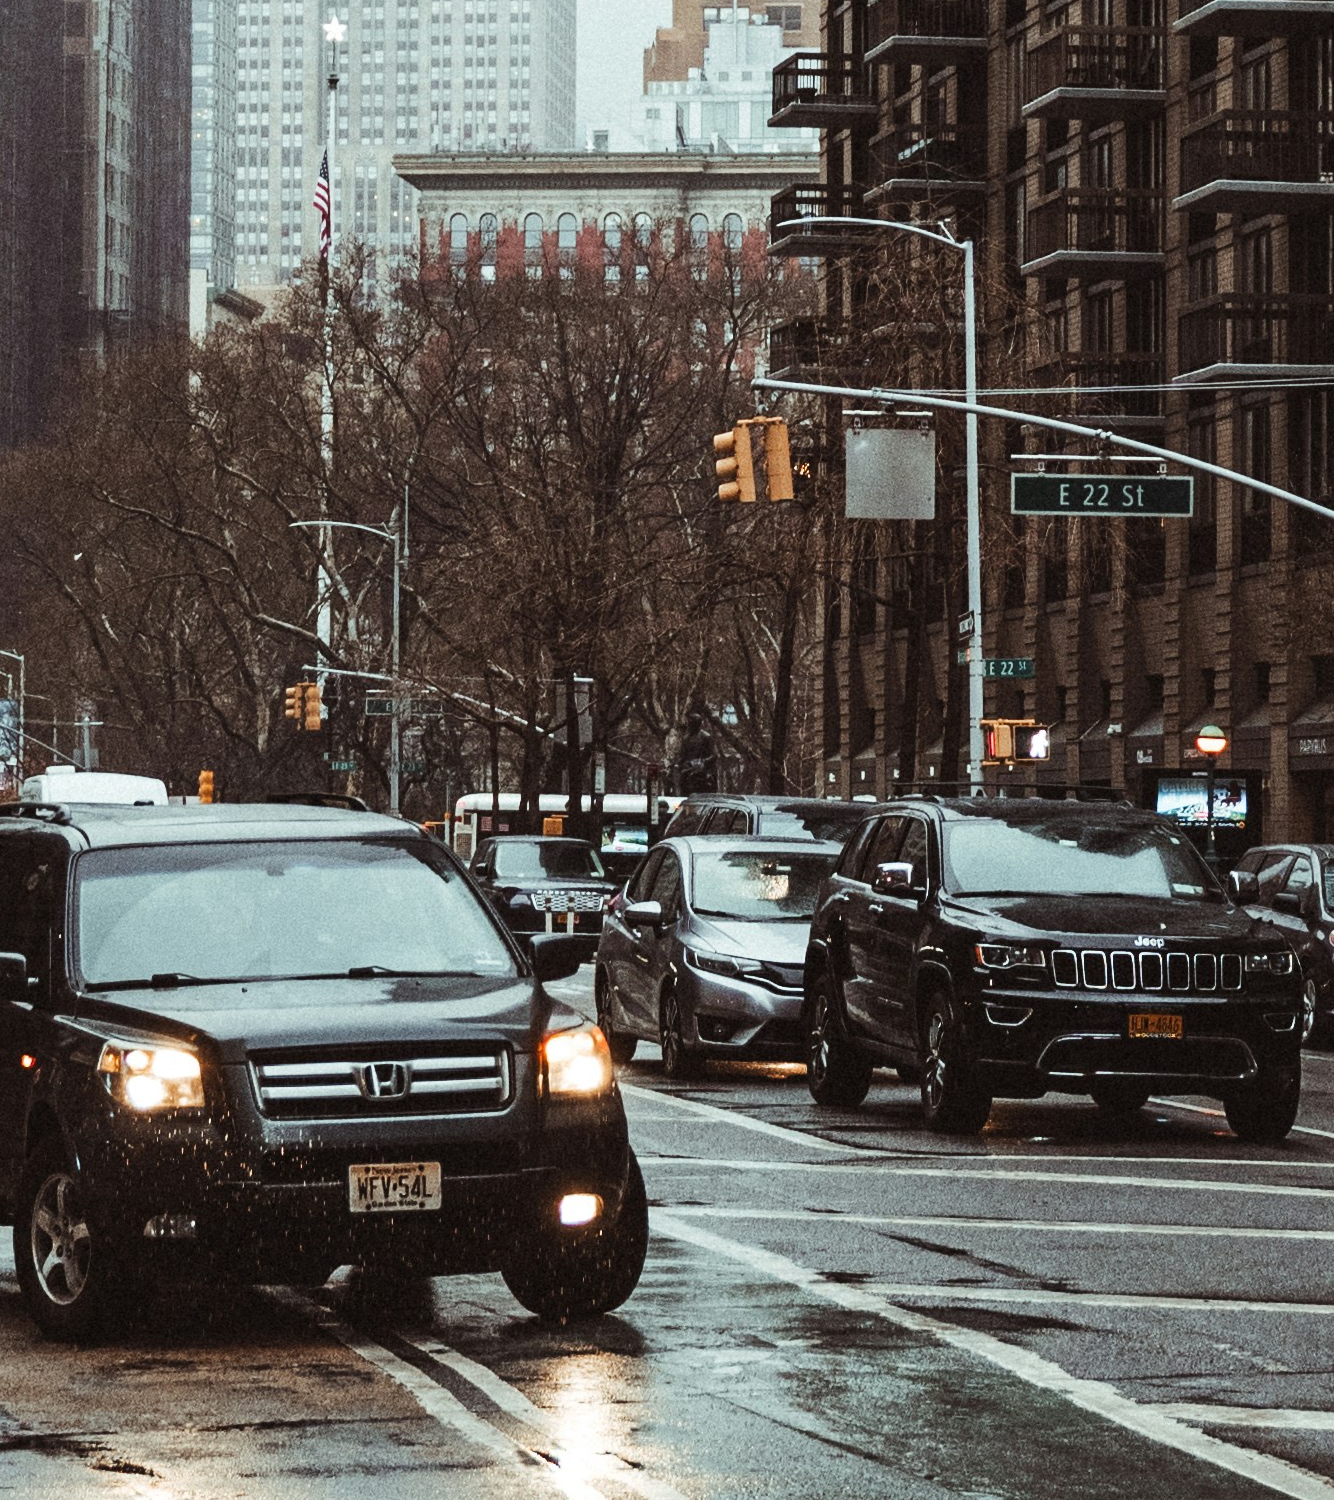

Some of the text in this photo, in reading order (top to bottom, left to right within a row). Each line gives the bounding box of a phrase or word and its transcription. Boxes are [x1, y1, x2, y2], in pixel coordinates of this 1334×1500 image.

[1060, 484, 1144, 507] E 22 St
[989, 661, 995, 675] E
[1000, 661, 1014, 676] 22
[1134, 936, 1165, 948] Jeep
